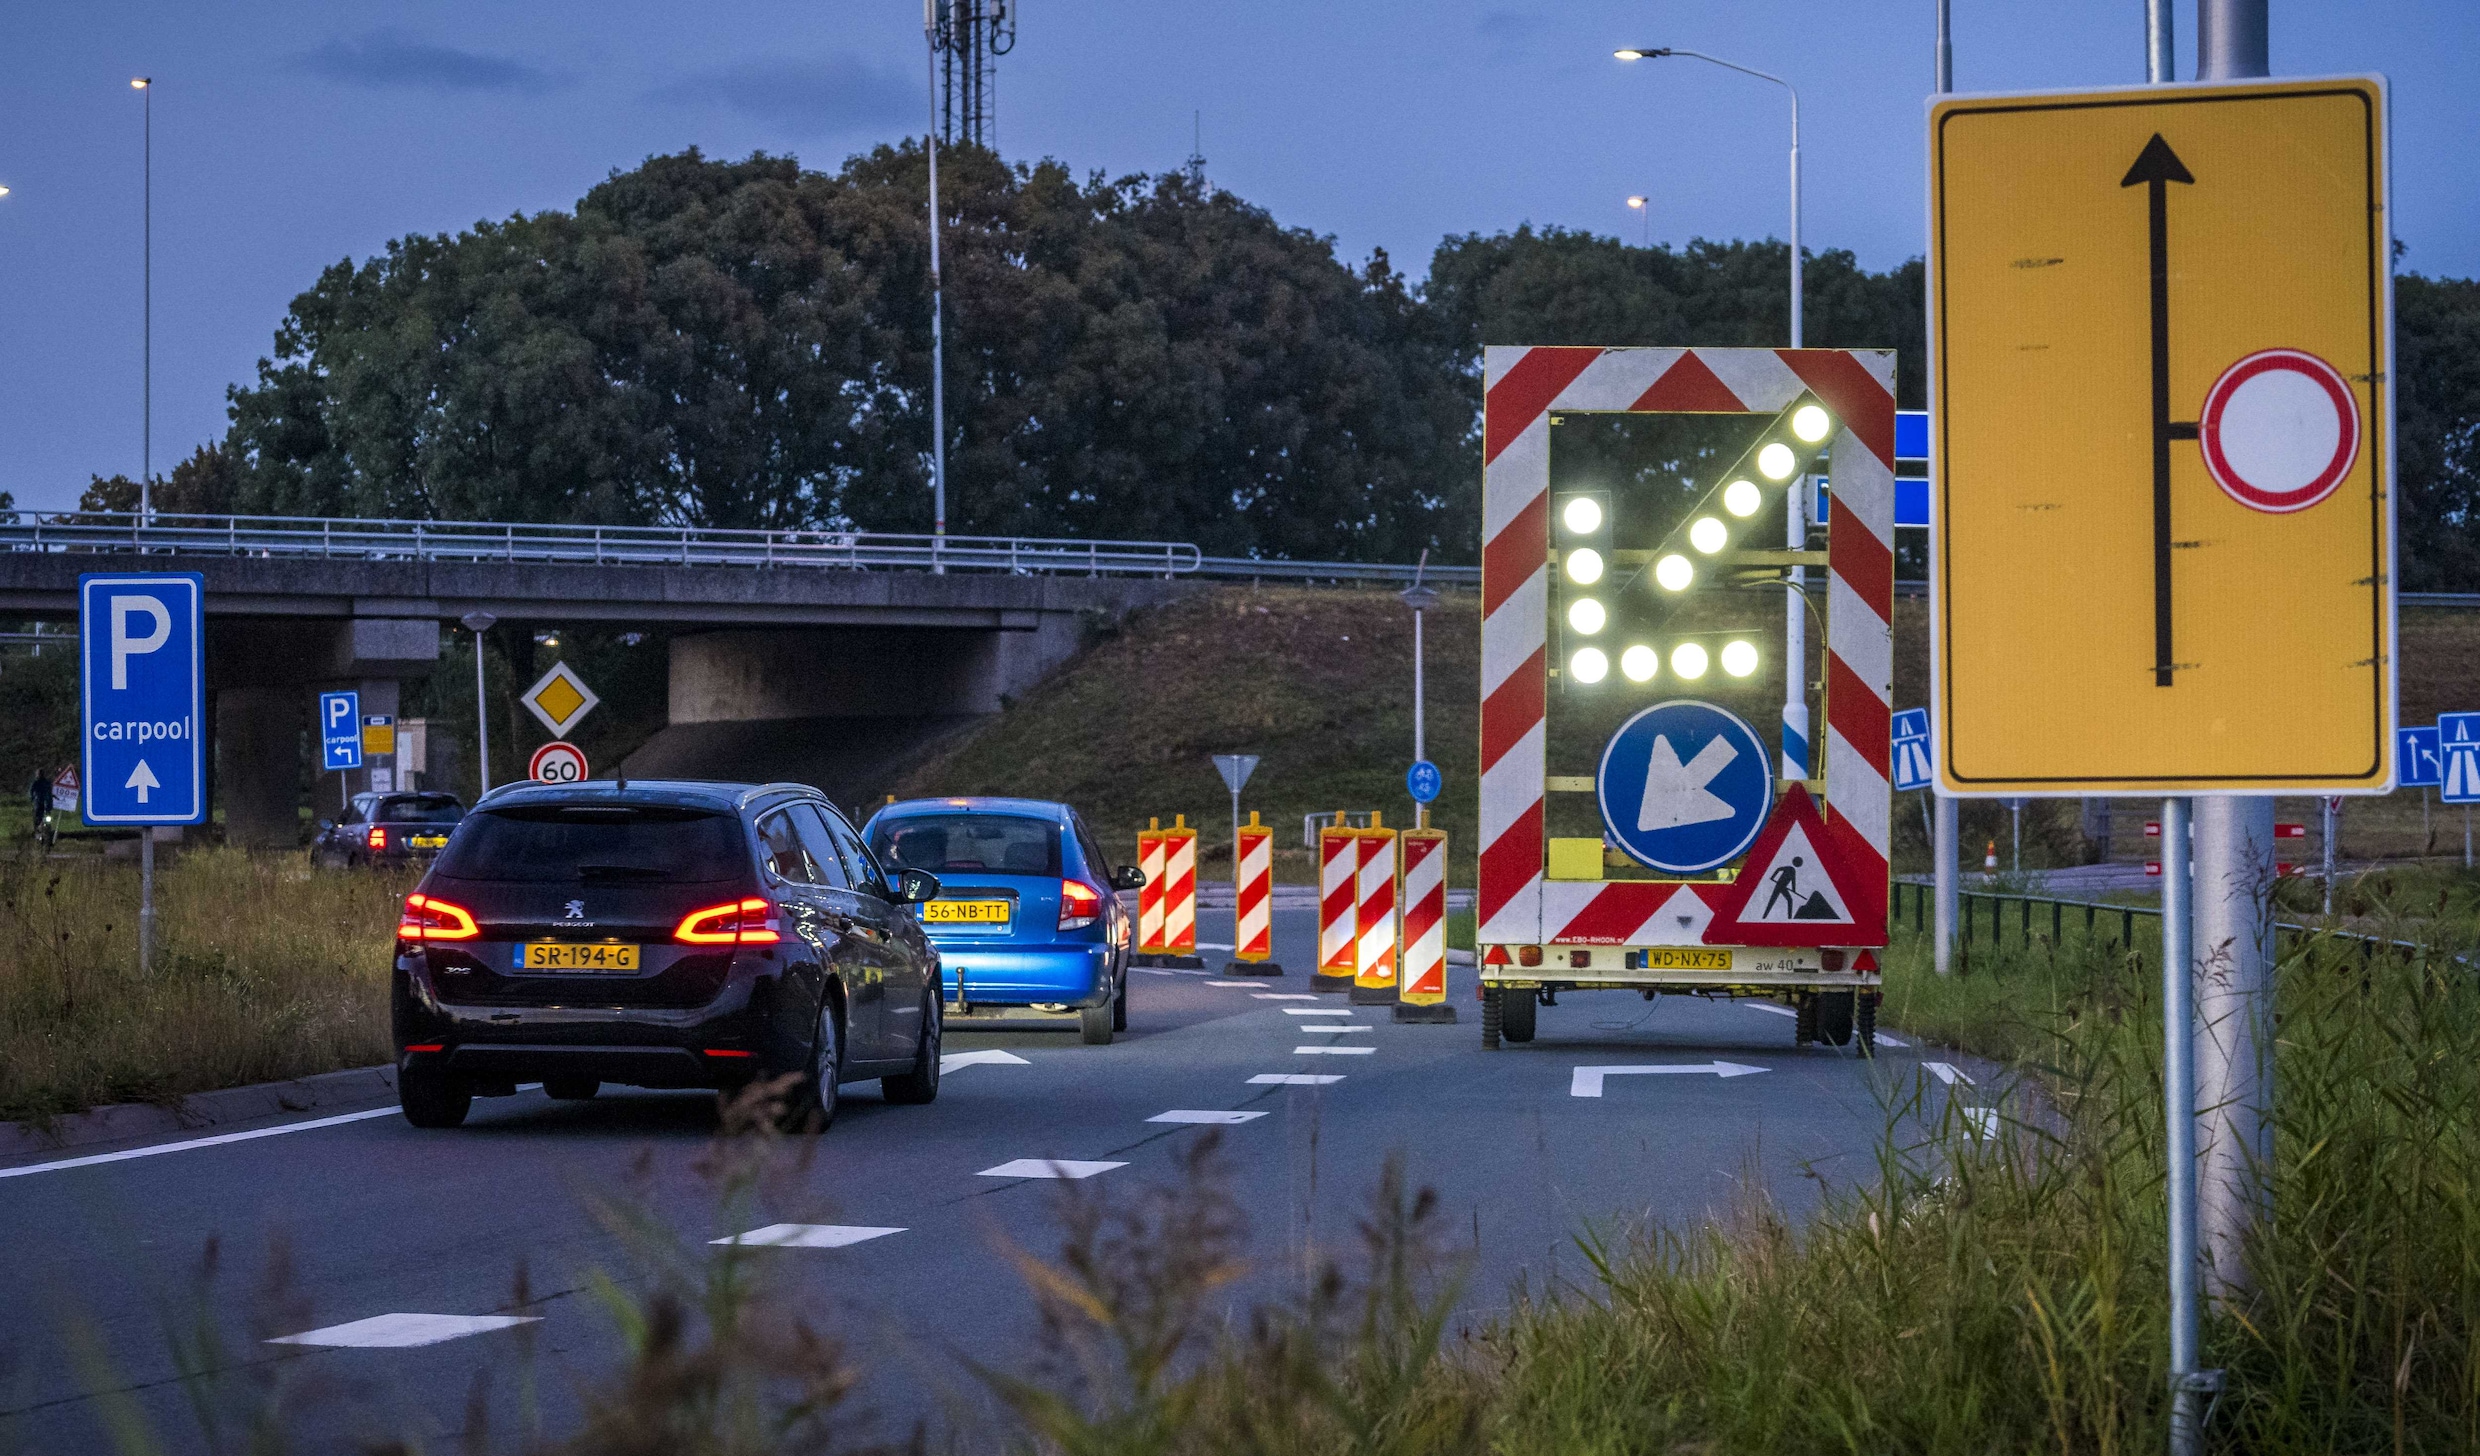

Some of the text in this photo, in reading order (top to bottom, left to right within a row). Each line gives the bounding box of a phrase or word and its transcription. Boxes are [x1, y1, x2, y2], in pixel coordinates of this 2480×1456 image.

[110, 594, 172, 691] P
[329, 697, 350, 729] P
[93, 715, 191, 746] carpool
[326, 734, 358, 745] carpool
[542, 760, 577, 781] 60
[929, 904, 1003, 919] 56-NB-TT
[1555, 936, 1625, 944] www.EBO-RHOON.nl
[532, 945, 630, 967] SR-194-G
[1652, 951, 1727, 967] WD-NX-75
[1755, 959, 1794, 971] aw 40
